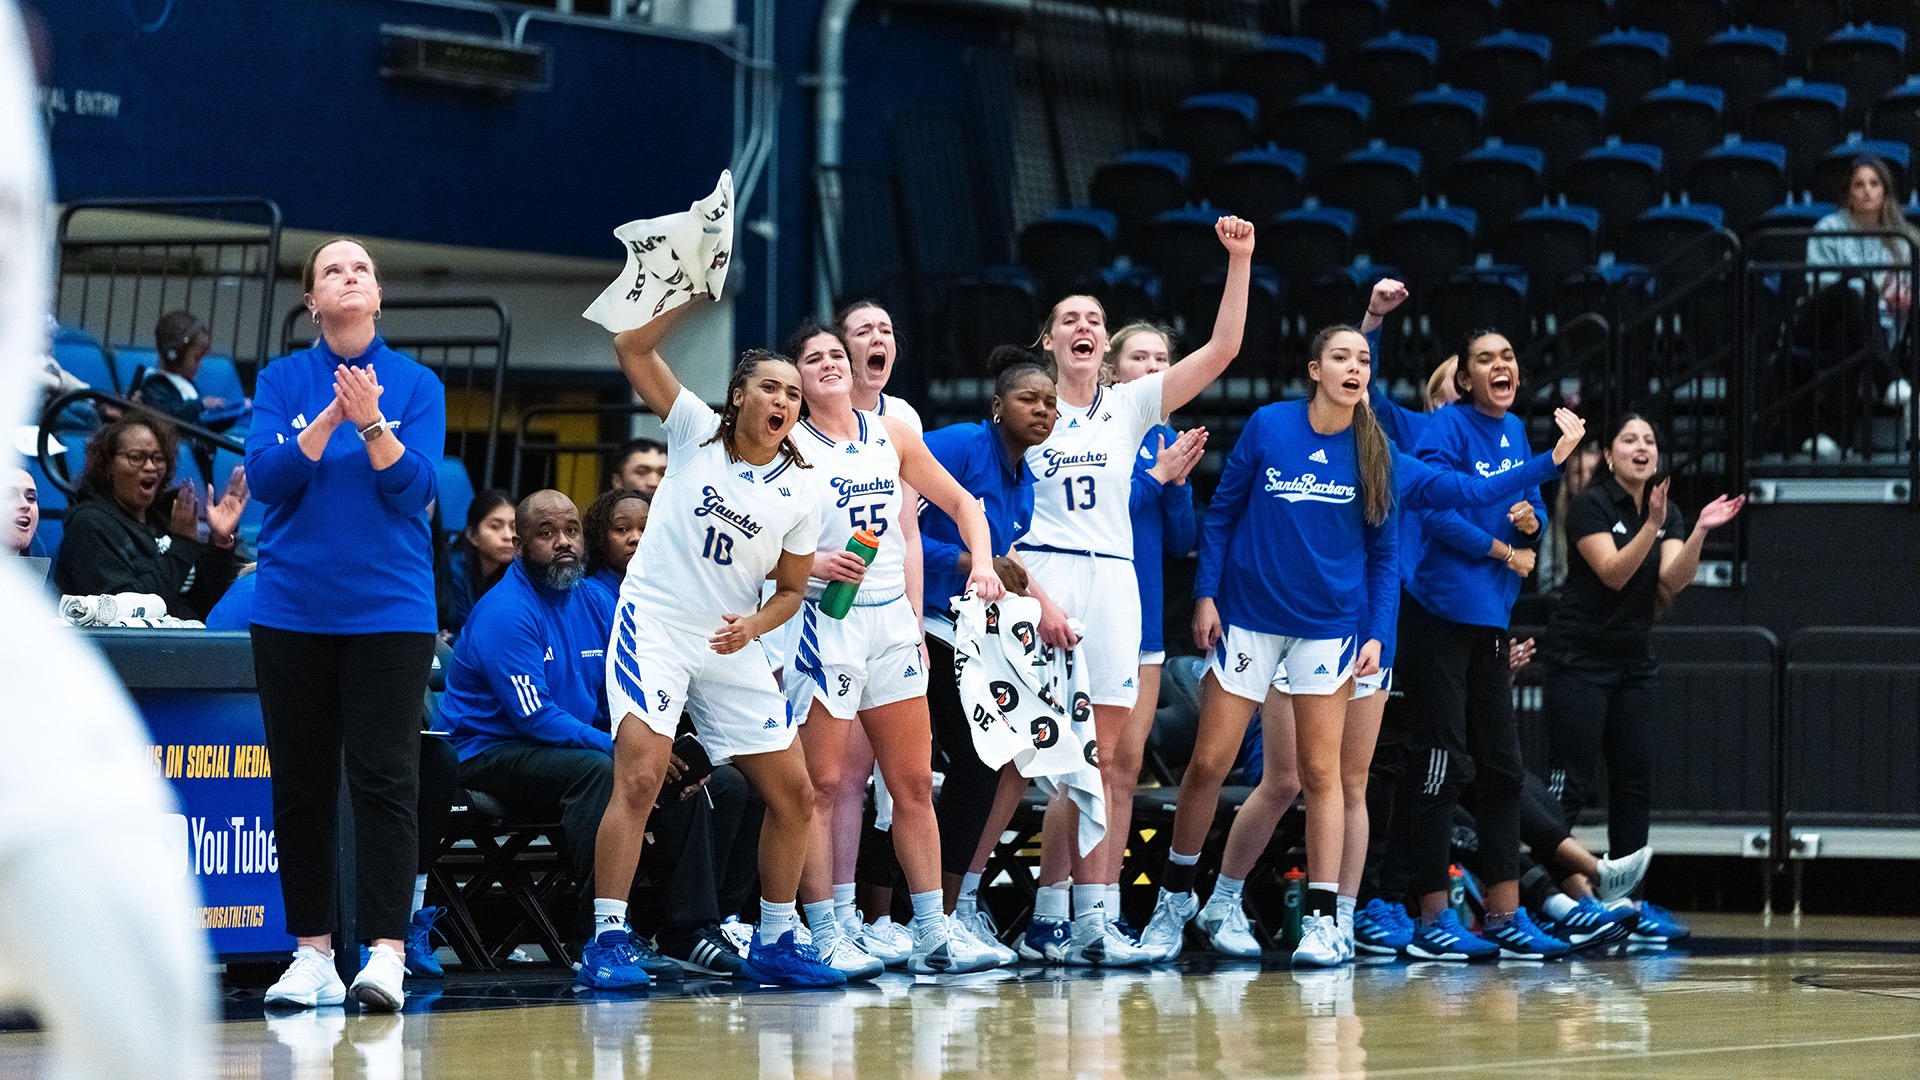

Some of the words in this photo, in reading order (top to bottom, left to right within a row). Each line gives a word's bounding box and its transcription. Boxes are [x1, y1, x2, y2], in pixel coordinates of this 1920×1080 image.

[1043, 448, 1108, 478] Gauchos
[830, 476, 895, 508] Gauchos
[1062, 475, 1096, 511] 13
[694, 485, 763, 538] Gauchos
[849, 503, 888, 537] 55
[702, 525, 734, 566] 10
[165, 745, 184, 778] ON
[186, 745, 230, 778] SOCIAL
[233, 745, 271, 778] MEDIA
[191, 816, 279, 875] YouTube
